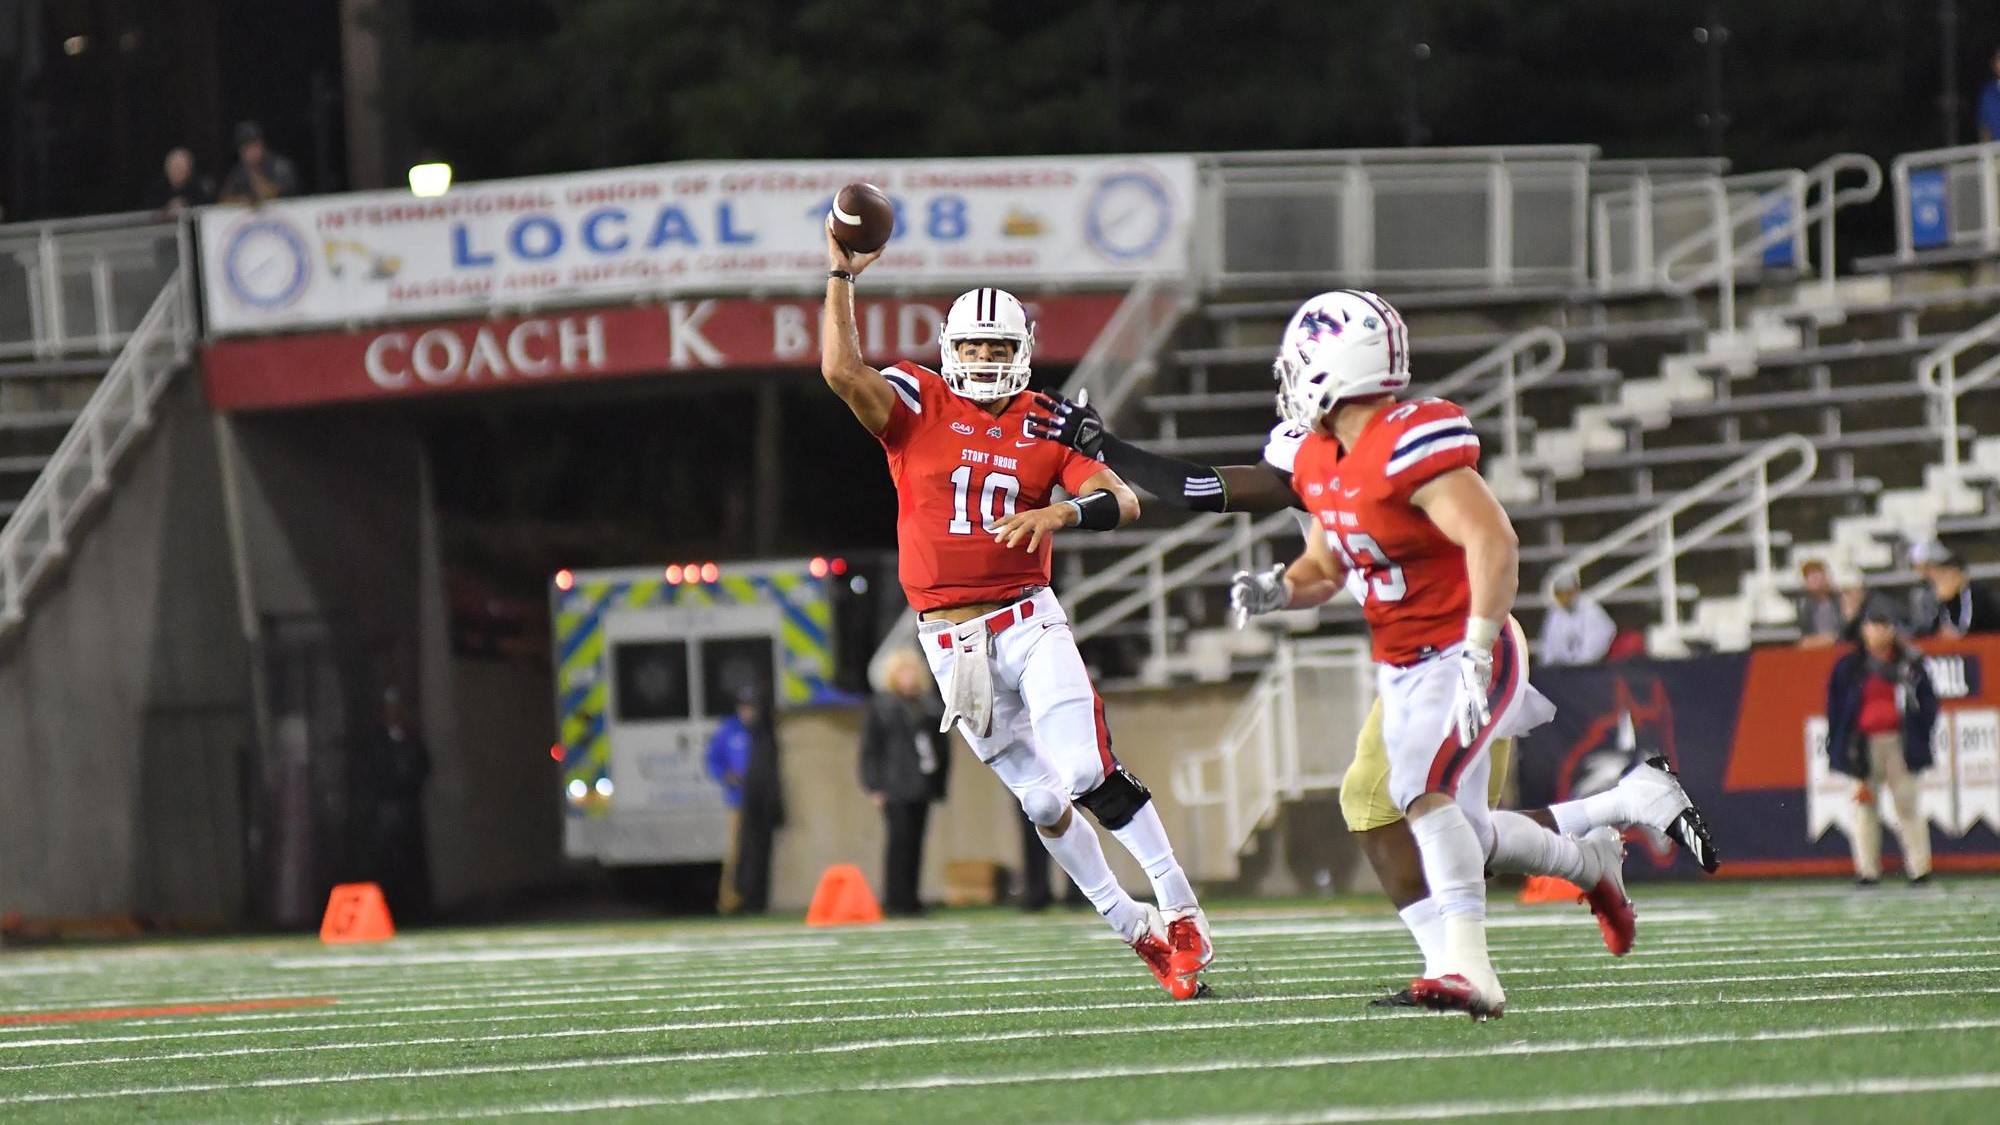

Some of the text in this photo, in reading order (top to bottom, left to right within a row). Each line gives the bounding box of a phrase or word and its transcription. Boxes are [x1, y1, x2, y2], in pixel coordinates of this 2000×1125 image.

[453, 200, 757, 270] LOCAL
[364, 313, 607, 390] COACH
[668, 298, 726, 369] K
[951, 421, 971, 433] CAA
[961, 448, 1018, 470] STONY BROOK
[949, 464, 1021, 535] 10
